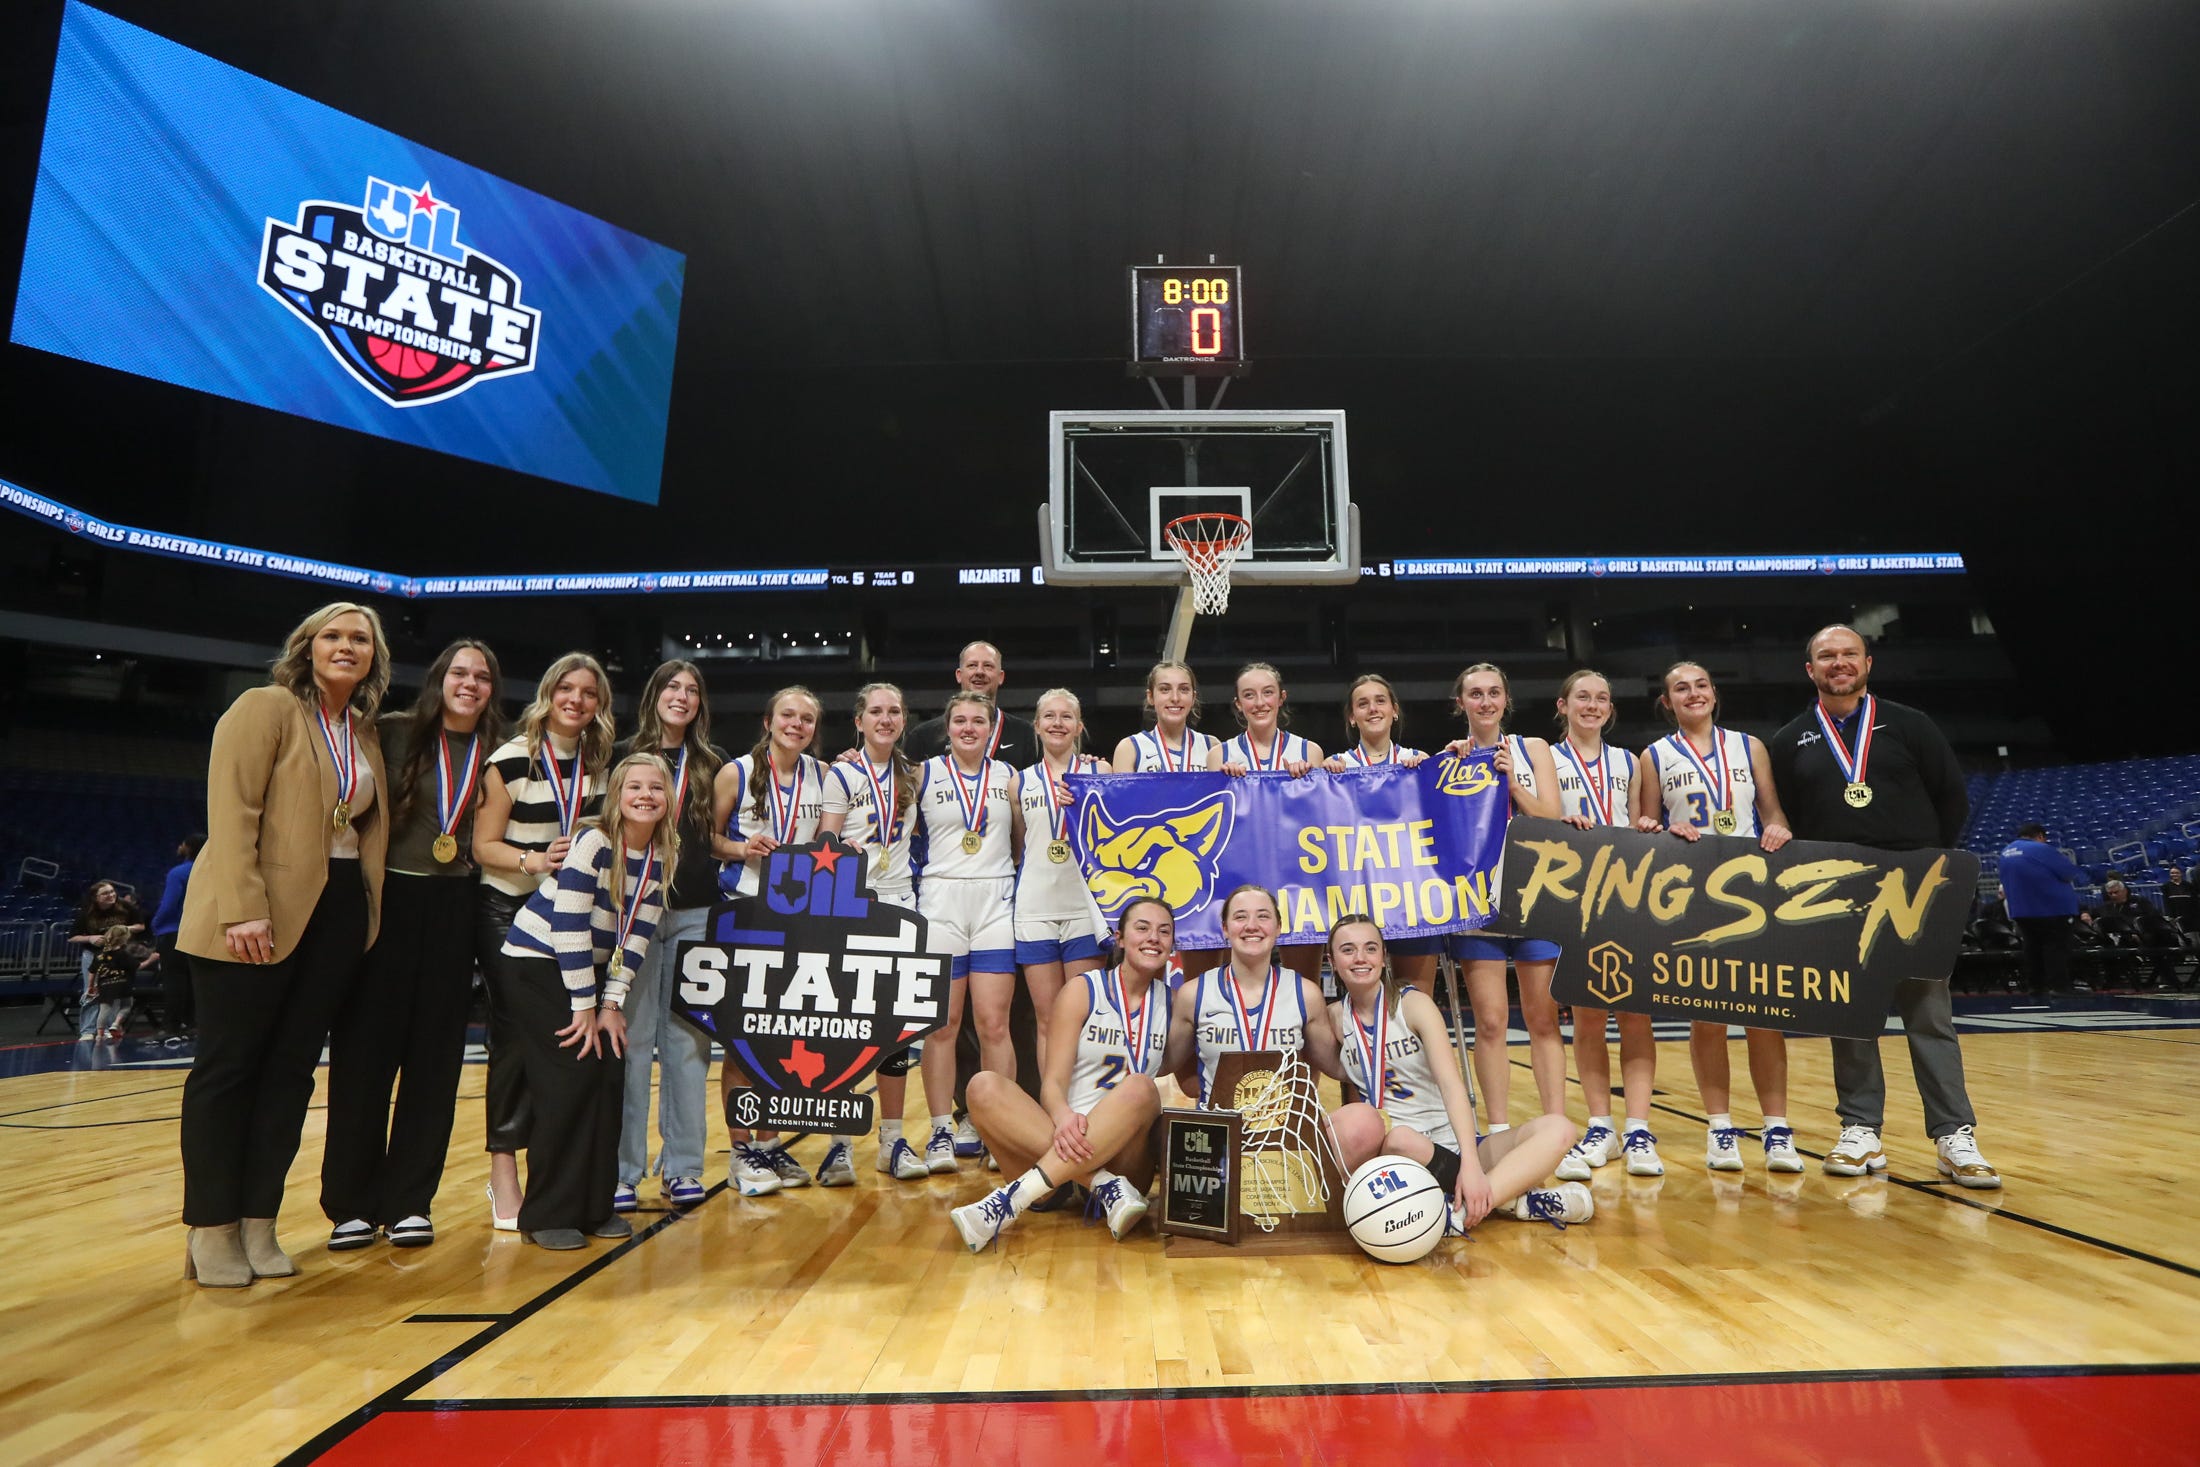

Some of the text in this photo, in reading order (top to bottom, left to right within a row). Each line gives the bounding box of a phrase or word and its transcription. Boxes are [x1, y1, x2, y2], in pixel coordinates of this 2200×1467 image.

[343, 230, 481, 294] BASKETBALL
[273, 234, 531, 360] STATE
[1163, 279, 1229, 305] 8:00
[321, 302, 483, 365] CHAMPIONSHIPS
[1190, 308, 1222, 355] 0
[0, 484, 65, 521] PIONSHIPS
[86, 521, 126, 542] GIRLS
[128, 532, 222, 560] BASKETBALL
[224, 548, 265, 567] STATE
[266, 556, 370, 586] CHAMPIONSHIPS
[1838, 558, 1868, 570] GIRLS
[1870, 557, 1934, 569] BASKETBALL
[1936, 557, 1964, 568] STATE
[874, 571, 896, 579] TEAM
[901, 570, 915, 585] 0
[959, 568, 1021, 585] NAZARETH
[1360, 563, 1391, 577] TOL 5
[1408, 563, 1474, 575] BASKETBALL
[1475, 562, 1503, 574] STATE
[1505, 561, 1587, 573] CHAMPIONSHIPS
[1607, 560, 1639, 573] GIRLS
[1641, 560, 1704, 572] BASKETBALL
[1706, 560, 1734, 571] STATE
[1735, 559, 1817, 571] CHAMPIONSHIPS
[424, 579, 456, 593] GIRLS
[457, 579, 524, 592] BASKETBALL
[525, 578, 554, 591] STATE
[555, 576, 639, 590] CHAMPIONSHIPS
[660, 575, 690, 588] GIRLS
[692, 574, 758, 587] BASKETBALL
[760, 573, 789, 586] STATE
[790, 572, 829, 585] CHAMP
[831, 575, 849, 584] TOL
[1435, 757, 1500, 796] Naz
[1298, 819, 1439, 874] STATE
[679, 946, 941, 1018] STATE
[1652, 952, 1850, 1004] SOUTHERN
[1652, 993, 1797, 1018] RECOGNITION INC.
[743, 1013, 873, 1040] CHAMPIONS
[768, 1096, 864, 1119] SOUTHERN
[768, 1118, 819, 1128] RECOGNITION
[1174, 1173, 1221, 1196] MVP
[1384, 1210, 1424, 1234] Baden
